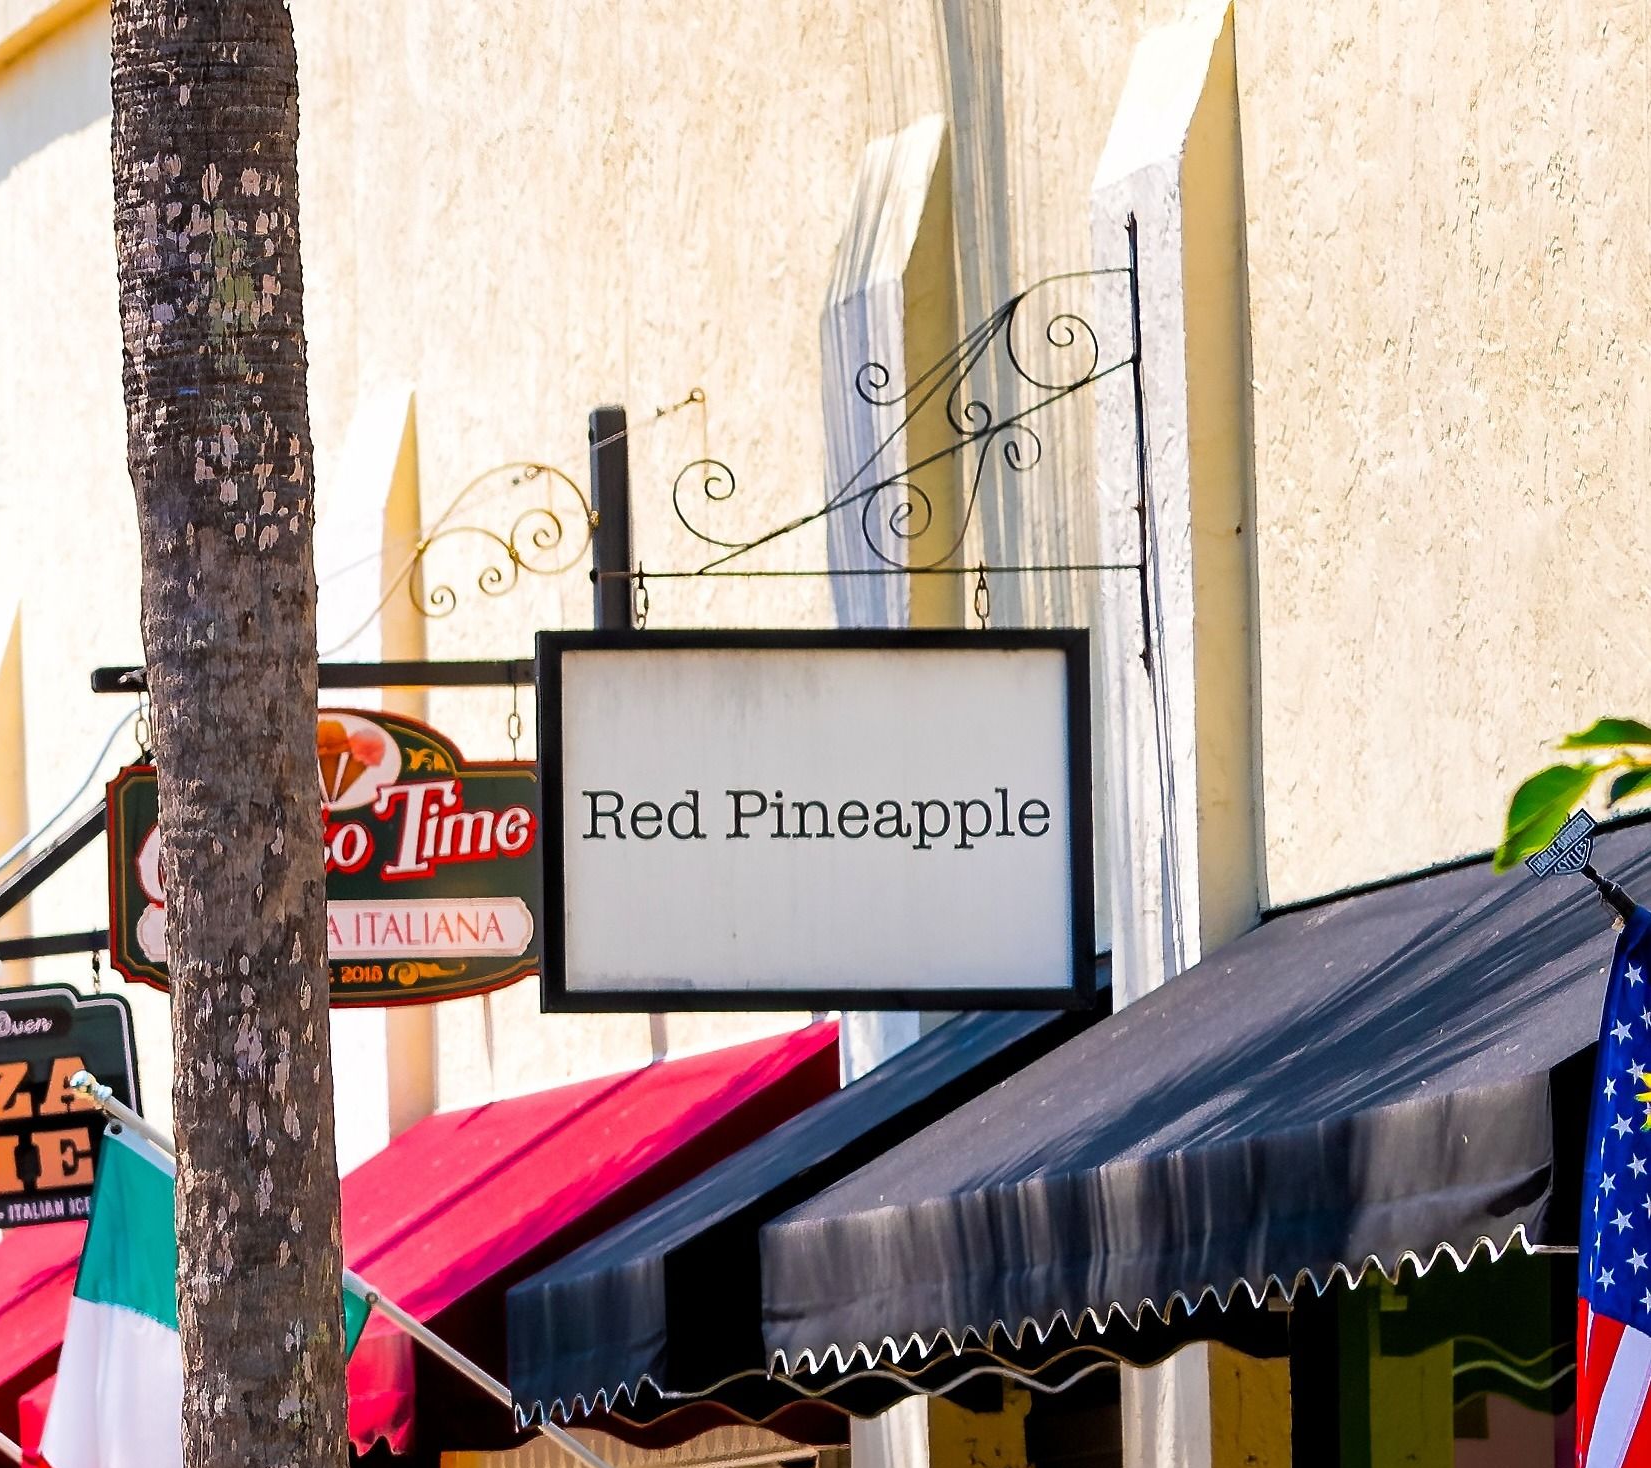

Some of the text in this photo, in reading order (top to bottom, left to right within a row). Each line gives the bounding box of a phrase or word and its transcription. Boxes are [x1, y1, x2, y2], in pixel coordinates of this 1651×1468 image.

[373, 779, 533, 876] Time
[582, 786, 1052, 850] Red Pineapple
[354, 911, 505, 945] ITALIANA
[7, 1198, 66, 1222] ITALIAN
